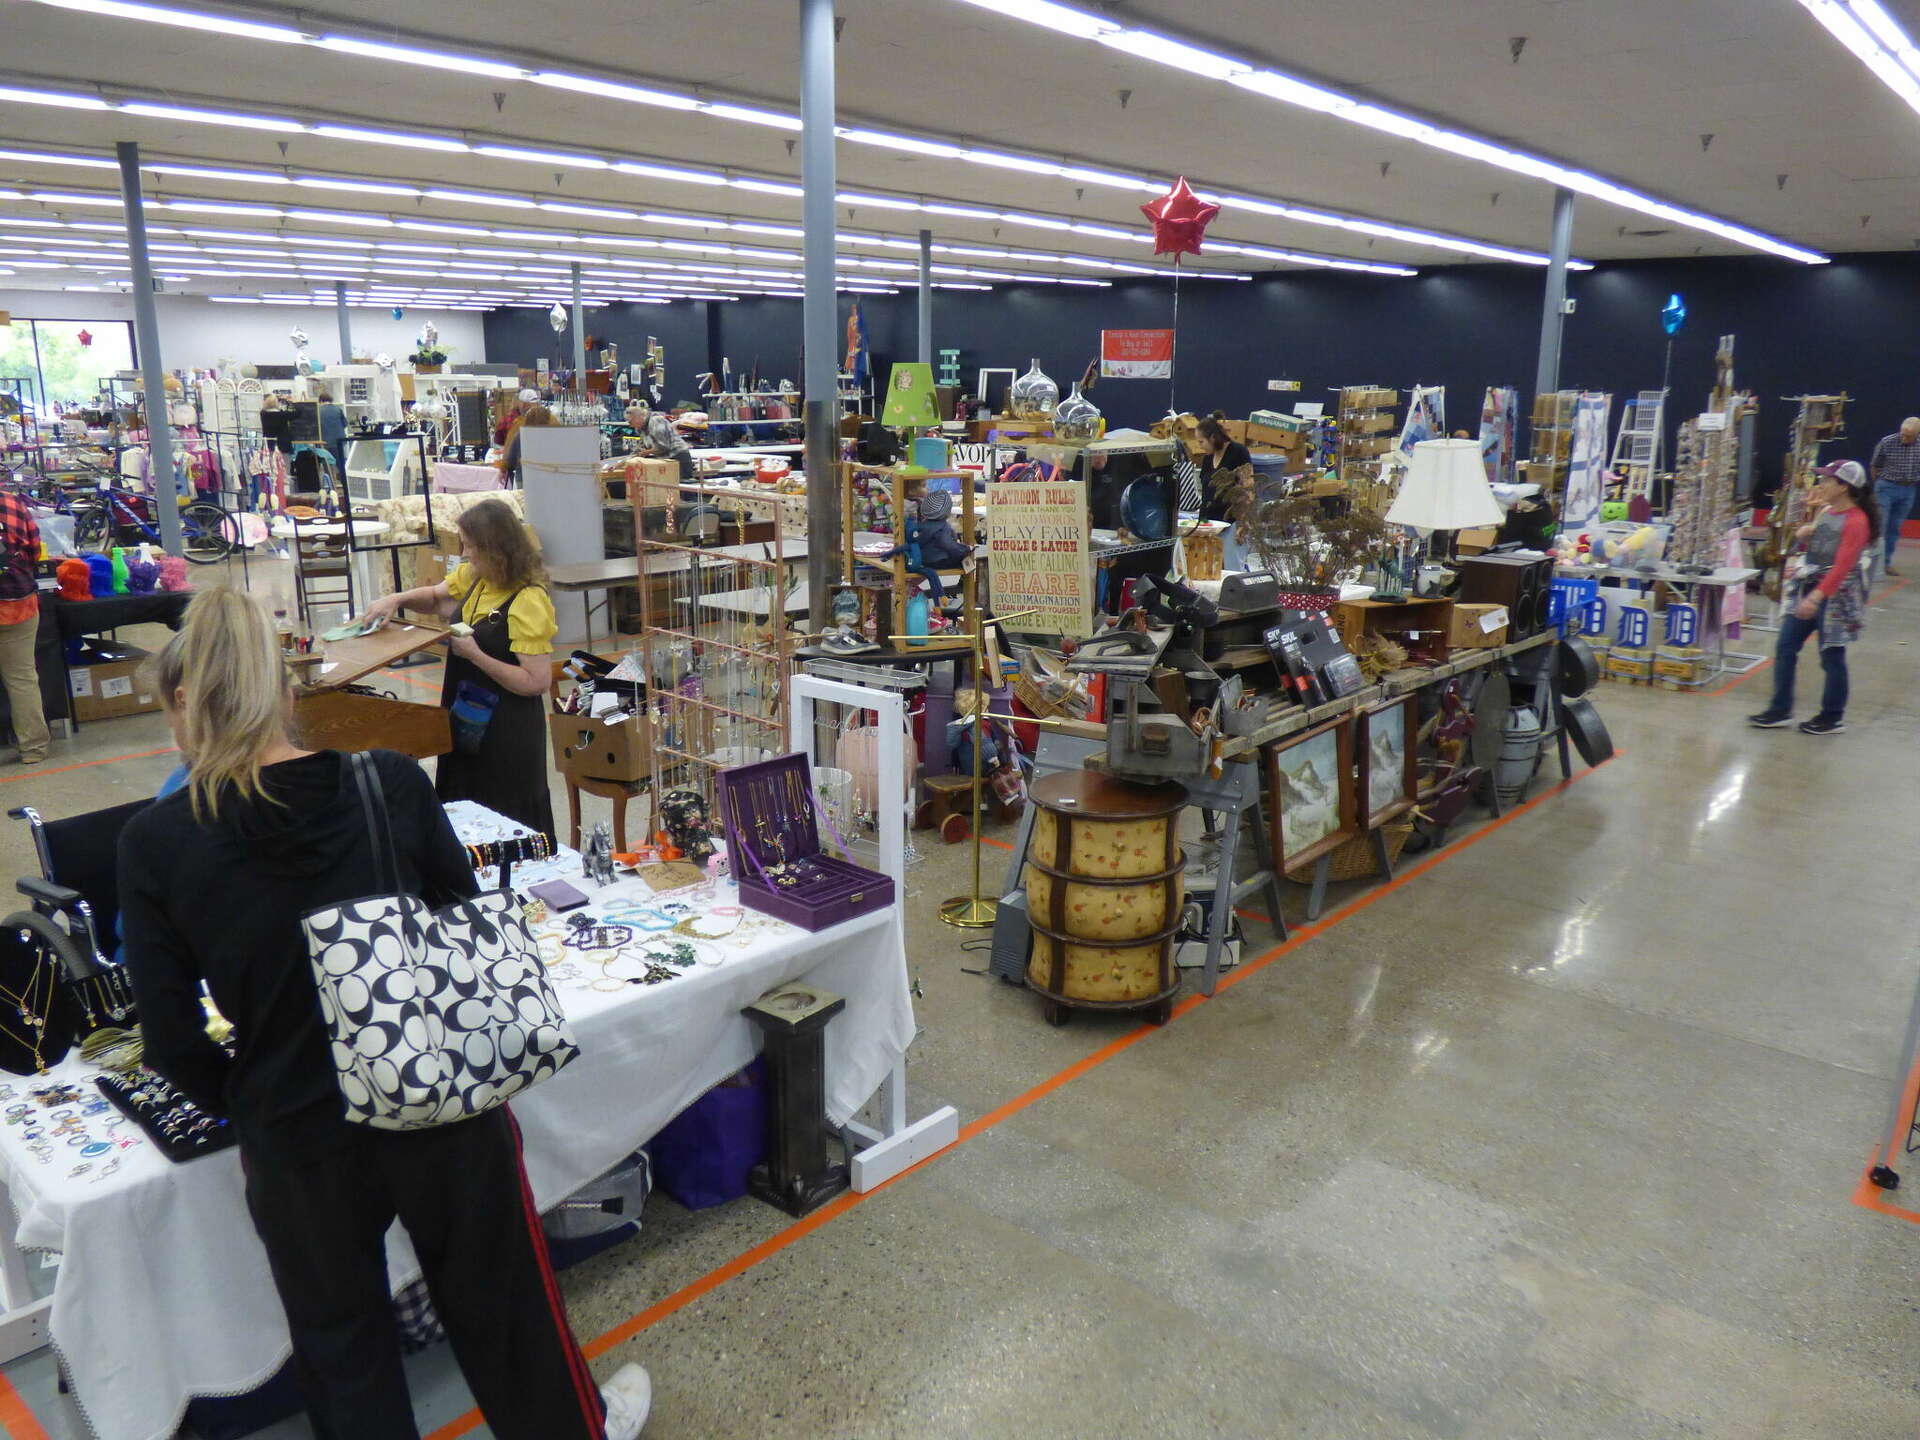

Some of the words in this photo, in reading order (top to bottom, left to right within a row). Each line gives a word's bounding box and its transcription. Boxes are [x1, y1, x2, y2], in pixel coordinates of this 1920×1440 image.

[1045, 488, 1076, 505] RULES
[992, 525, 1035, 539] PLAY
[1041, 526, 1080, 540] FAIR
[992, 540, 1029, 551] GIGGLE
[1040, 541, 1078, 553] LAUGH
[993, 551, 1007, 570] NO
[1010, 553, 1036, 571] NAME
[1040, 553, 1080, 573] CALLING
[995, 572, 1080, 595] SHARE
[1000, 594, 1023, 605] YOUR
[1023, 595, 1080, 607] IMAGINATION
[1048, 607, 1081, 615] YOURSELF
[1281, 632, 1298, 645] SKIL
